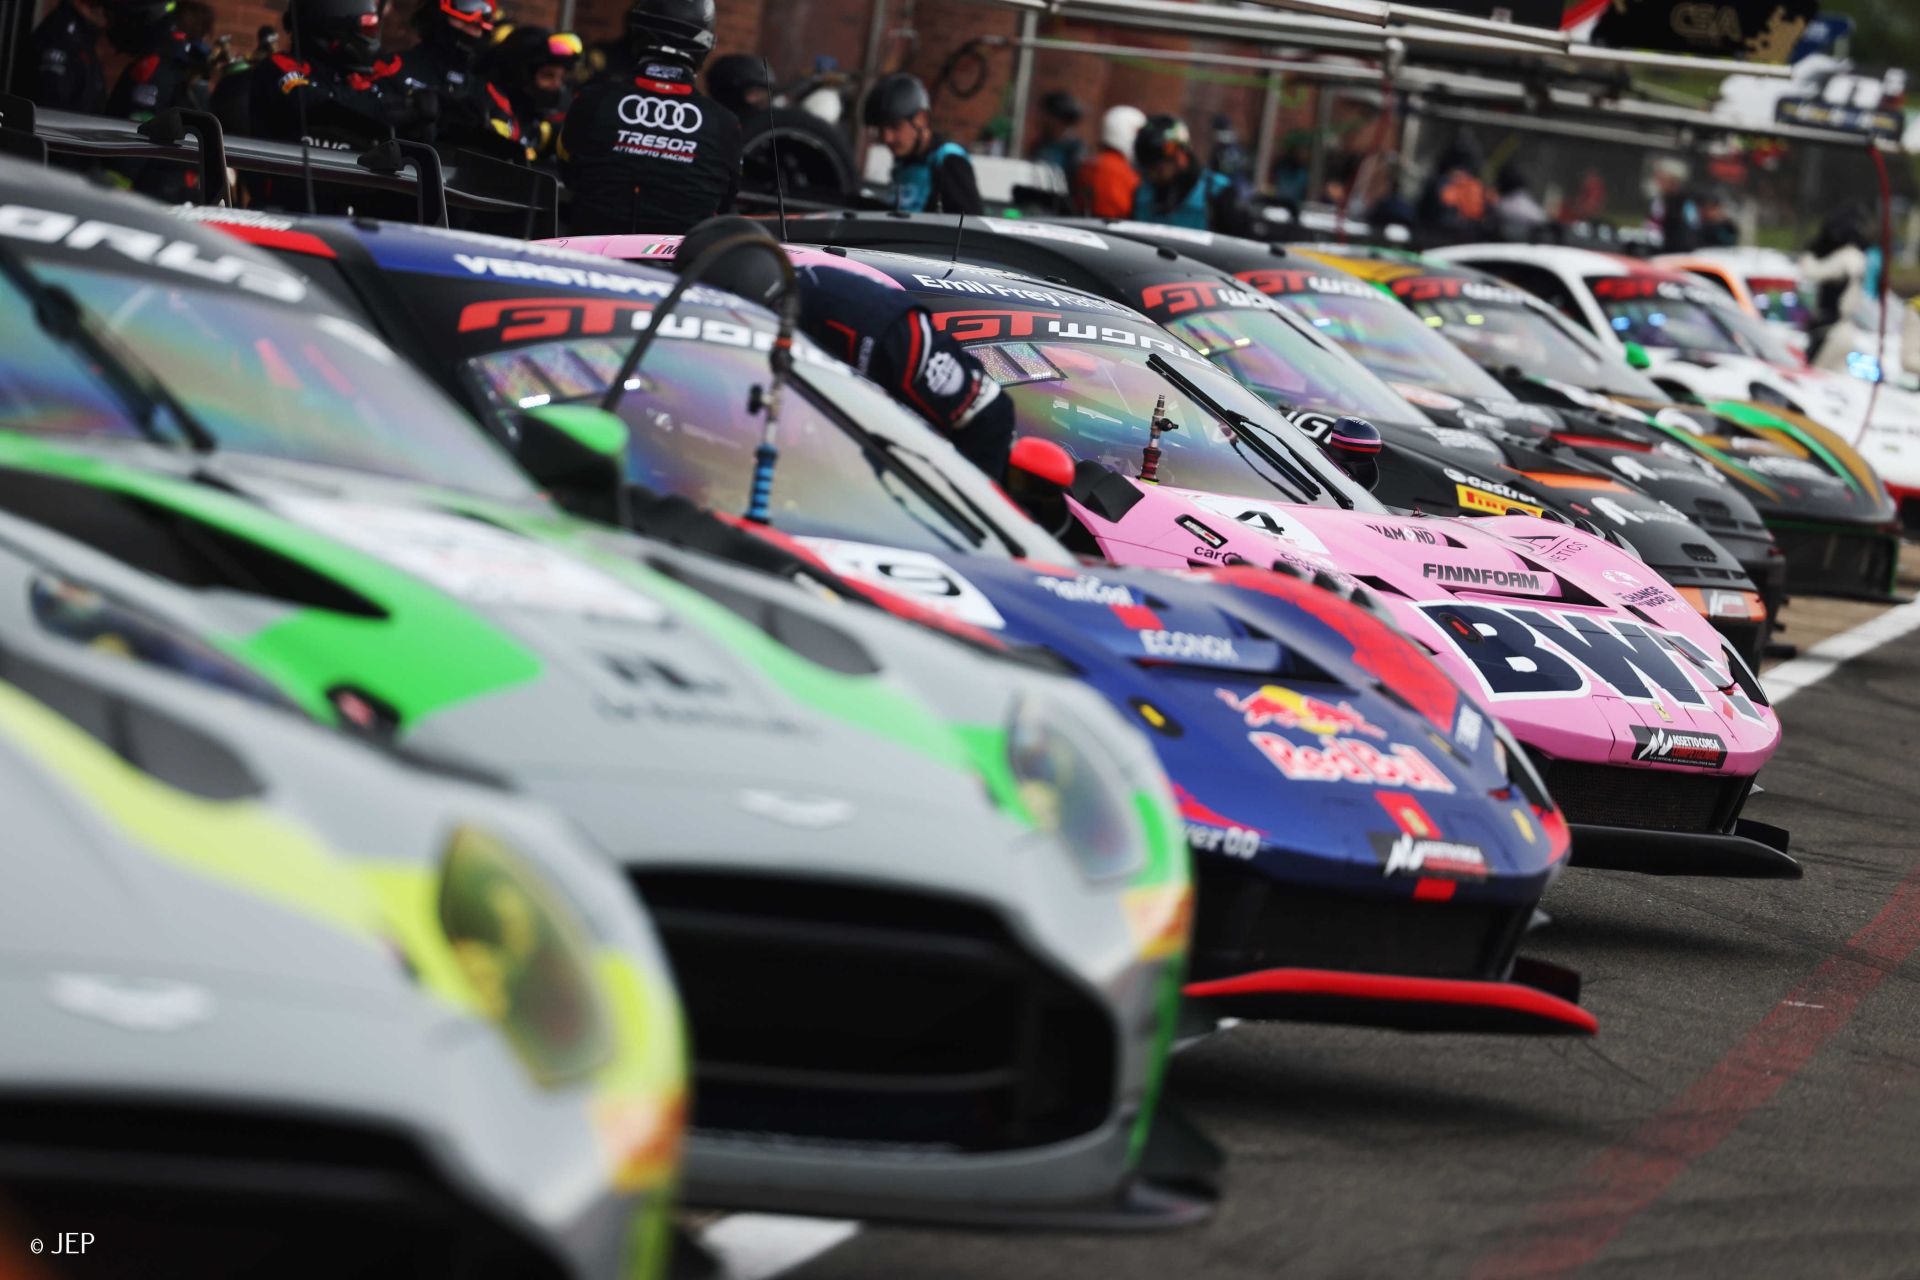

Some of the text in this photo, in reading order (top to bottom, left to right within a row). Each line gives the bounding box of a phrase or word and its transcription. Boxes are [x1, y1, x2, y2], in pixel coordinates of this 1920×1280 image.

[612, 144, 695, 163] ATTEMPTO RACING
[617, 129, 698, 154] TRESOR
[910, 273, 994, 296] Emil
[997, 283, 1061, 307] Frey
[1142, 281, 1223, 314] GT
[458, 297, 656, 342] GT
[930, 308, 1062, 341] GT
[1422, 561, 1540, 591] FINNFORM
[1672, 733, 1721, 751] ASSETTO CORSA
